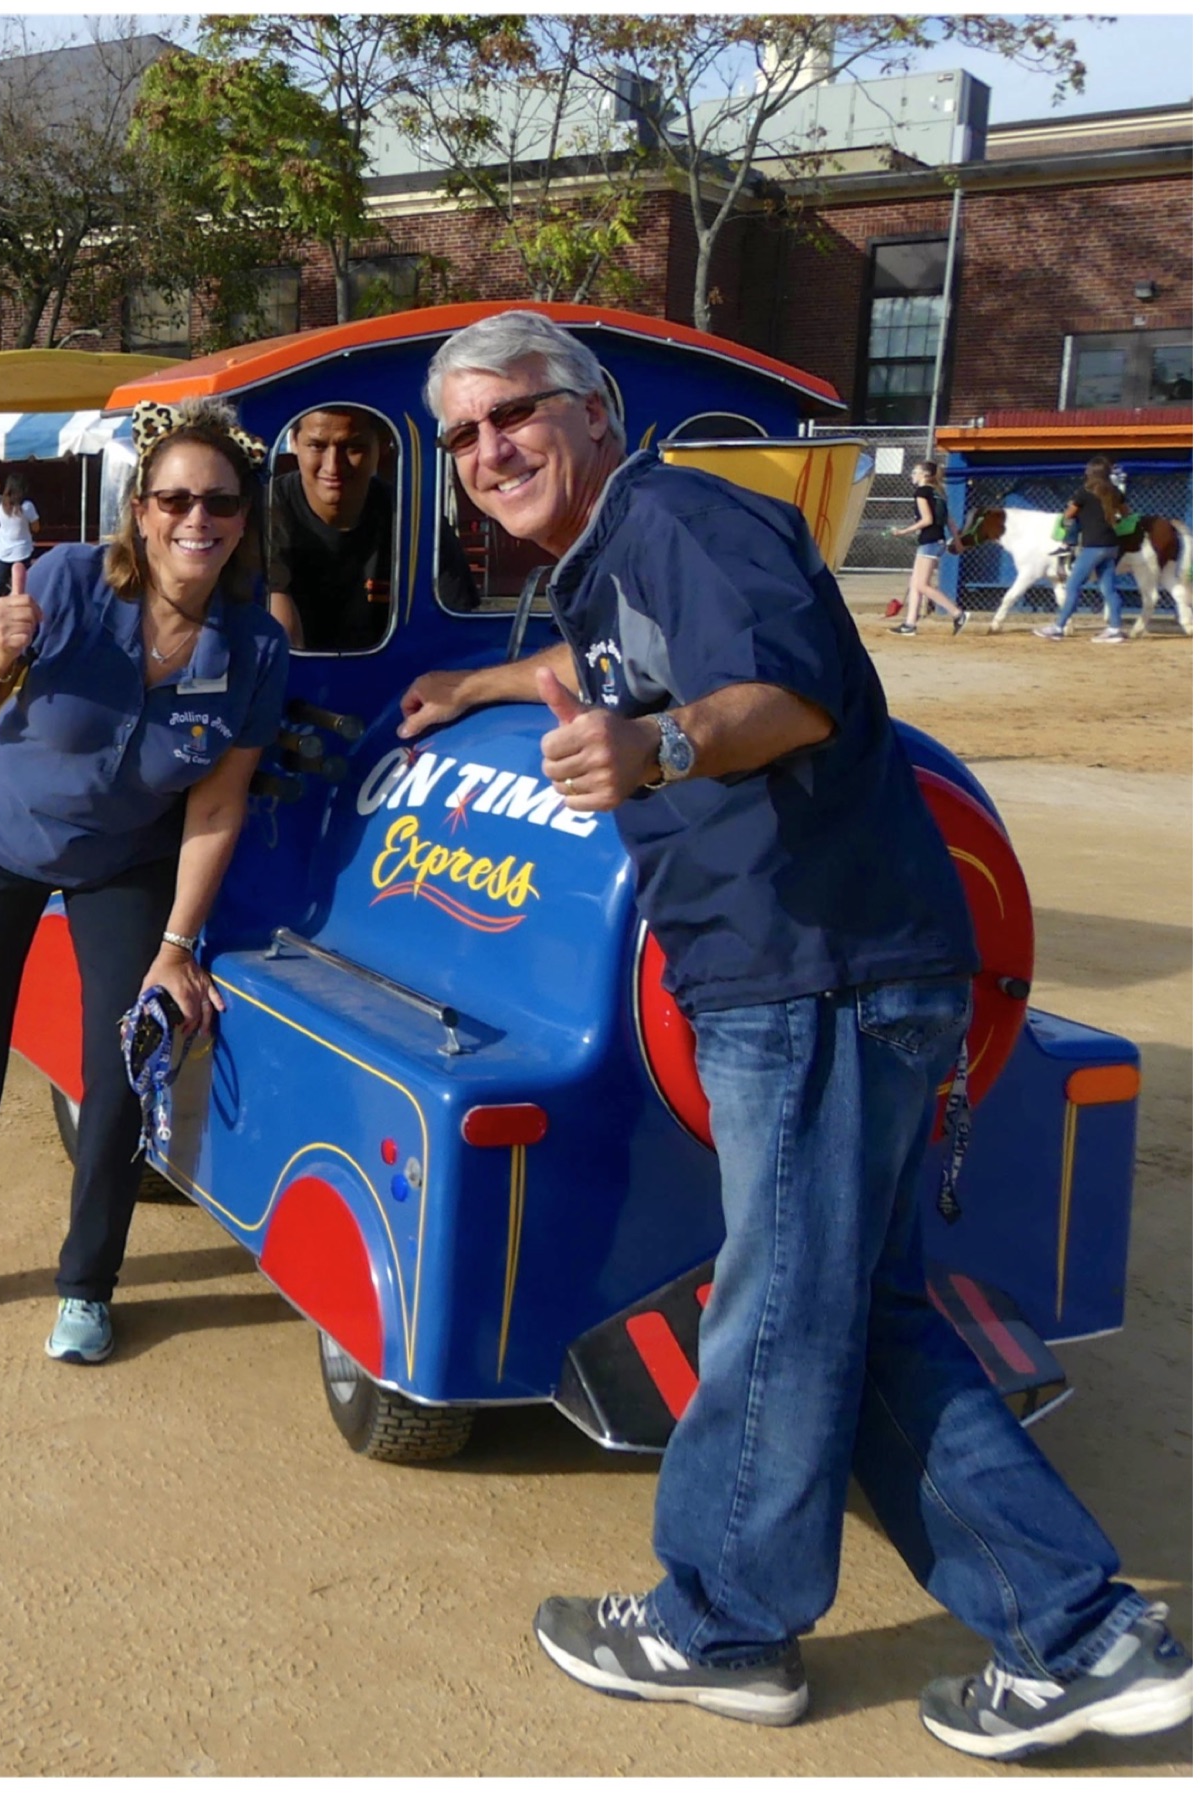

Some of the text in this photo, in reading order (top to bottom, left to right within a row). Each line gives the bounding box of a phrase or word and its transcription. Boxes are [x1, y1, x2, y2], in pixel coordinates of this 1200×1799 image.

[169, 711, 209, 726] Rolling
[356, 747, 599, 838] ON TIME
[371, 814, 541, 908] Express
